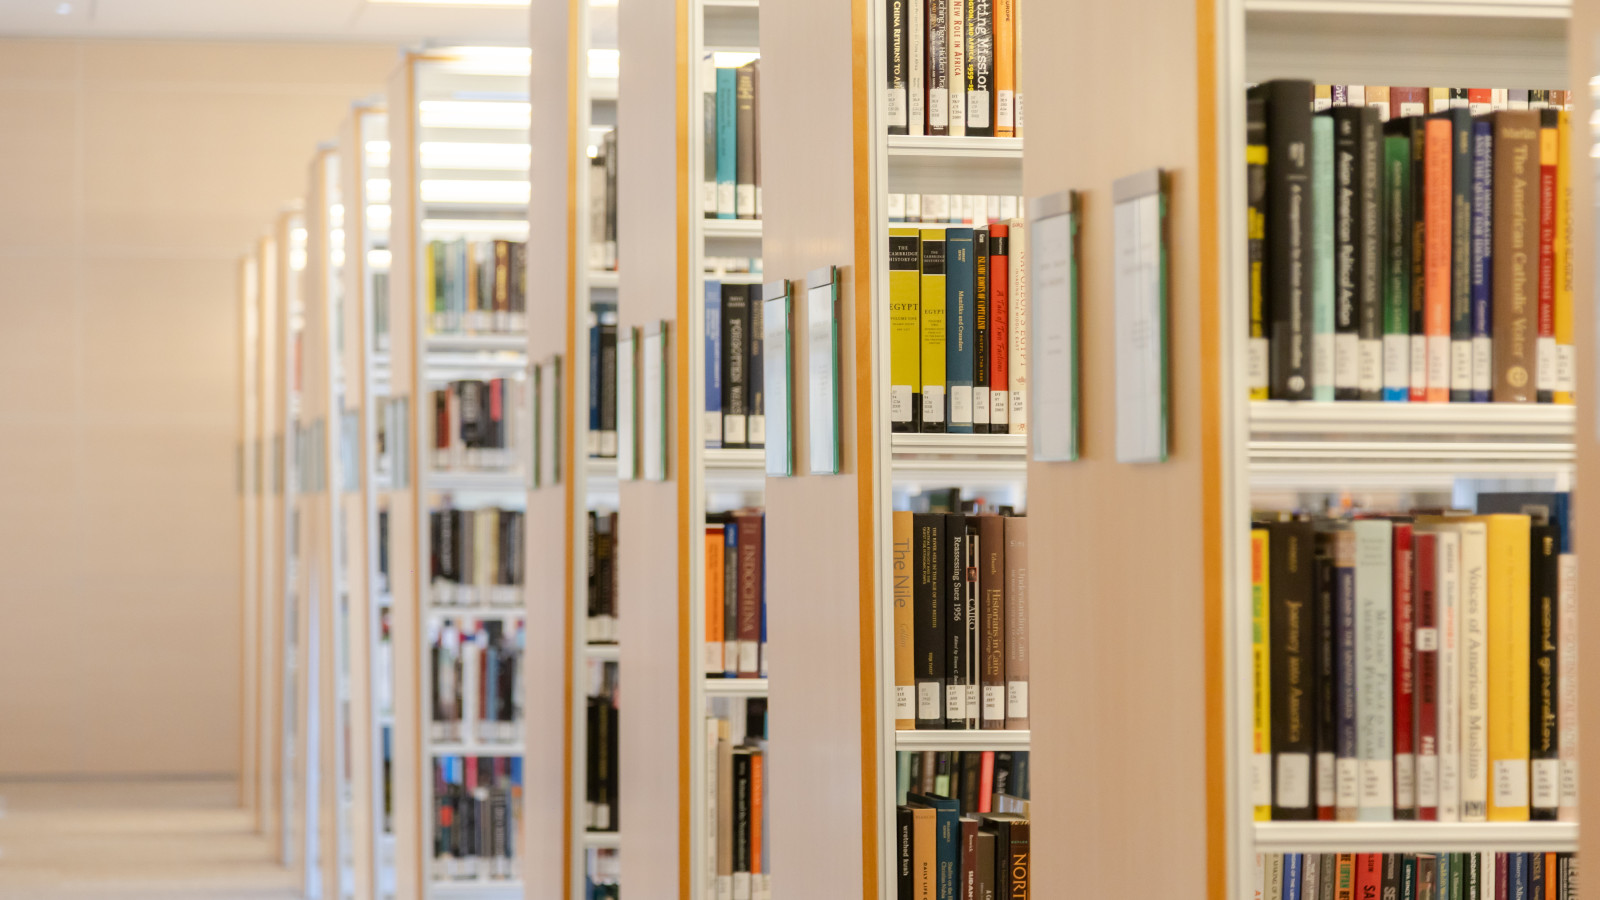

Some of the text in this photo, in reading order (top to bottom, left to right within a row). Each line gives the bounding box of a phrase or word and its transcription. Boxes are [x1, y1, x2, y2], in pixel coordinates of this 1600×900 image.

[953, 1, 962, 17] NEW
[894, 1, 902, 75] CHINA RETURNS TO
[953, 20, 962, 38] ROLE
[967, 23, 975, 62] AND AFRICA,
[936, 47, 947, 74] Hidden
[953, 51, 962, 77] AFRICA
[1474, 135, 1484, 157] AND
[1474, 160, 1484, 179] THE
[1367, 201, 1377, 235] ASIAN
[1474, 216, 1484, 236] FOR
[1340, 152, 1354, 326] Asian American Political Action
[1511, 145, 1528, 358] The American Catholic Voter
[1543, 175, 1553, 300] LEARNING TO BE CHINESE
[977, 256, 987, 275] ISLAMIC
[1367, 238, 1377, 302] AMERICANS
[1474, 238, 1484, 285] IDENTITY
[977, 276, 987, 292] ROOTS
[890, 303, 918, 311] EGYPT
[977, 299, 987, 330] CAPITALISM
[996, 300, 1005, 314] Tale
[957, 316, 965, 352] and Crusaders
[996, 327, 1005, 341] Two
[996, 344, 1005, 372] Factions
[743, 544, 756, 632] INDOCHINA
[895, 538, 911, 608] The Nile
[952, 536, 962, 622] Reassessing Suez 1956
[1402, 550, 1413, 591] Muslims
[968, 598, 976, 630] CAIRO
[1402, 592, 1413, 601] in
[1402, 603, 1413, 619] the
[992, 589, 1002, 676] Historians in Cairo
[1016, 568, 1027, 662] Understanding Cairo
[1402, 622, 1413, 645] West
[1362, 598, 1376, 708] AMERICAN PUBLIC
[1286, 601, 1303, 742] Journey into America
[1467, 566, 1482, 779] Voices of American Muslims
[1536, 596, 1556, 752] second generation
[1375, 672, 1387, 710] PLACE
[902, 825, 910, 877] wretched kush
